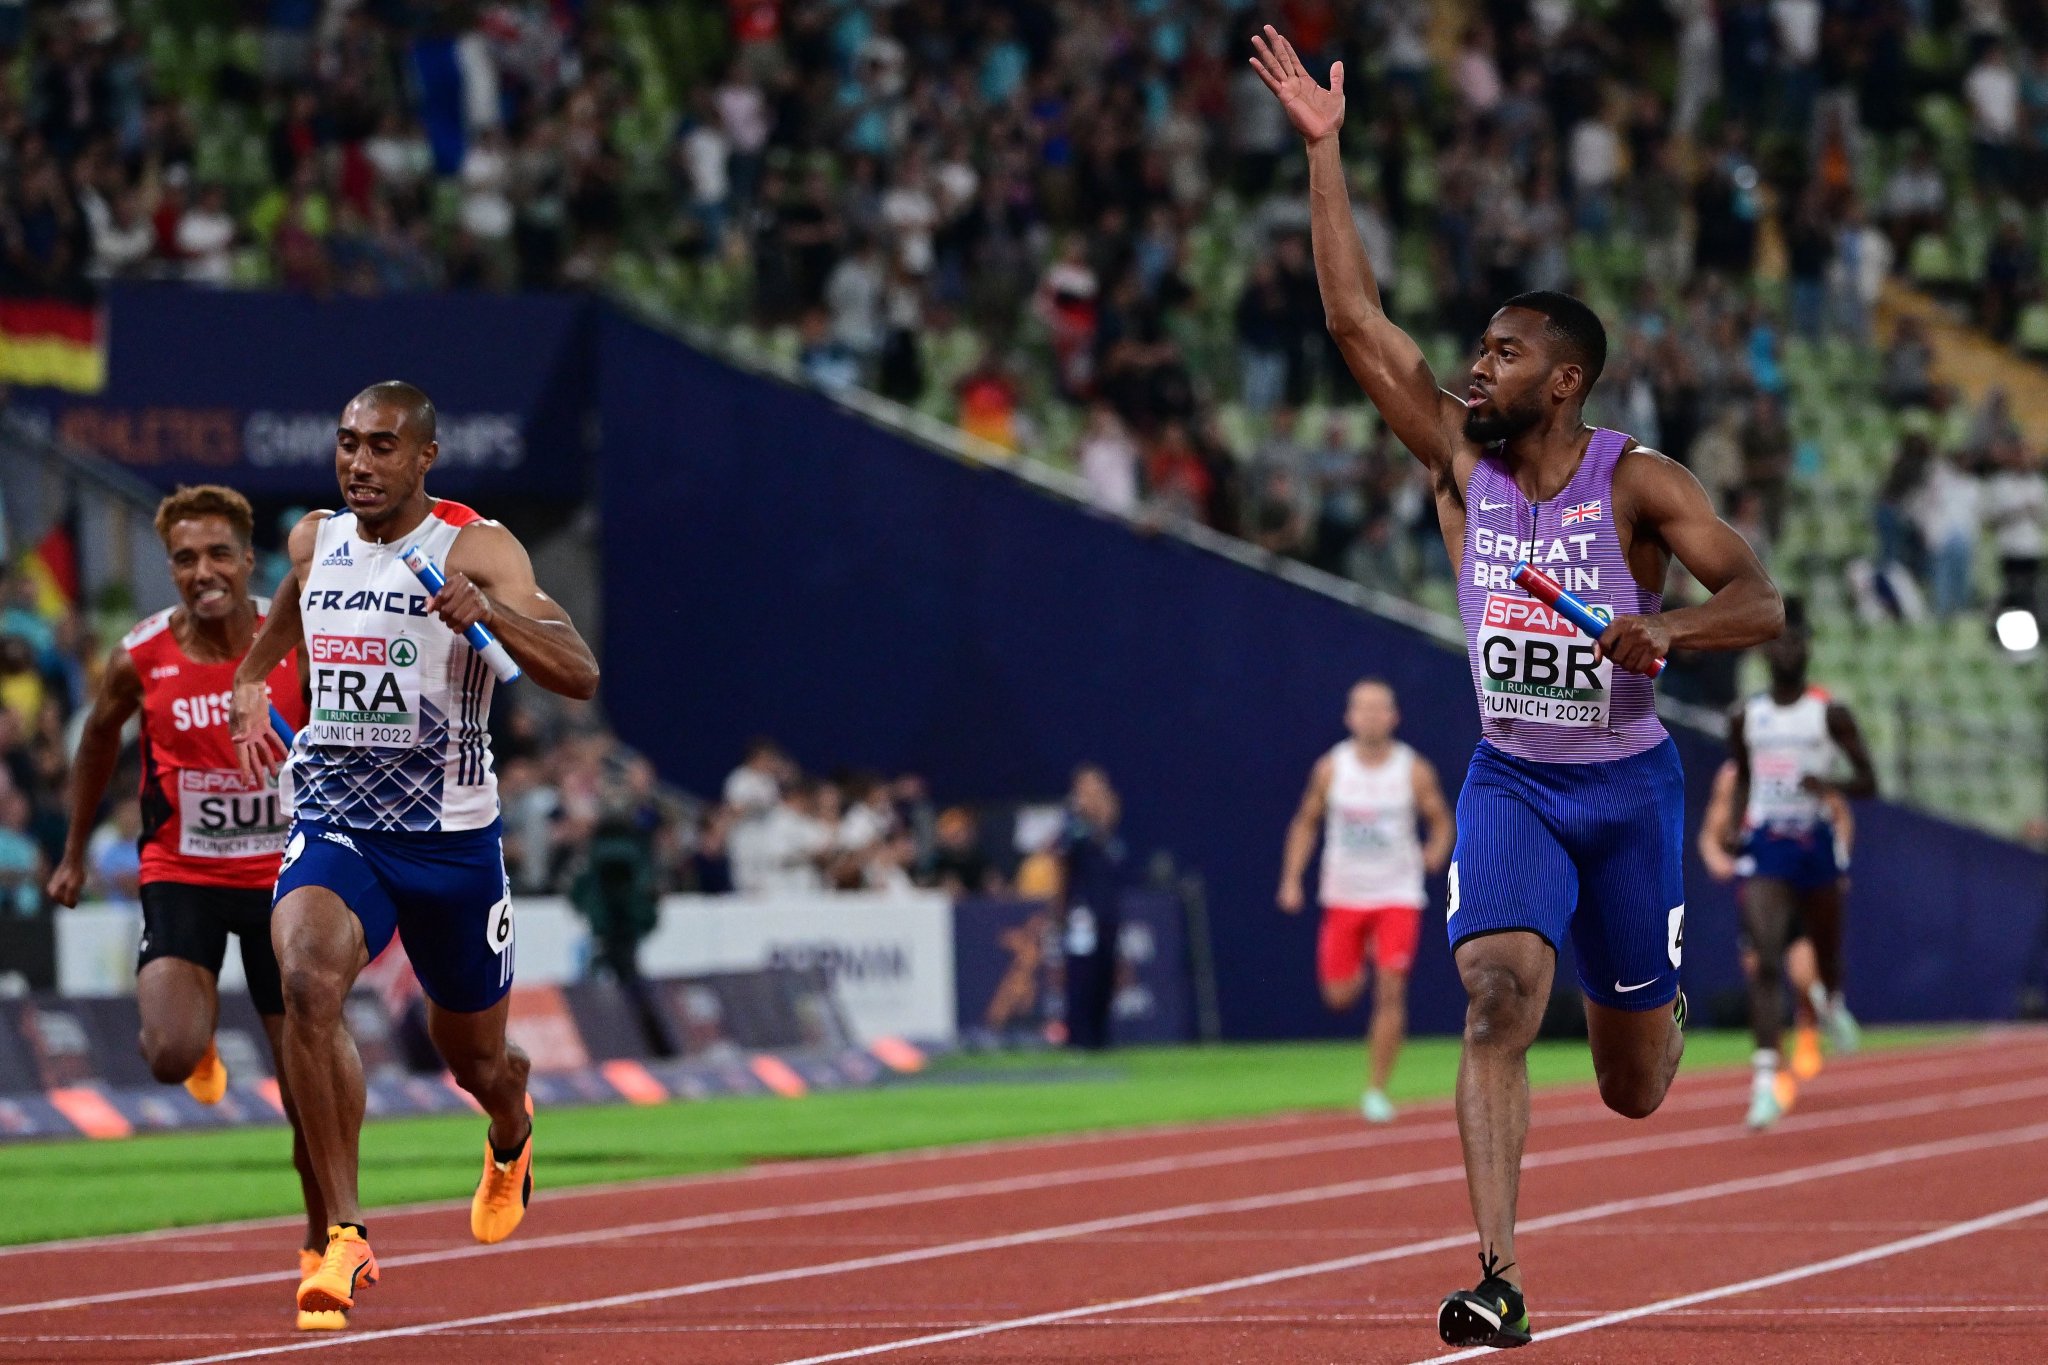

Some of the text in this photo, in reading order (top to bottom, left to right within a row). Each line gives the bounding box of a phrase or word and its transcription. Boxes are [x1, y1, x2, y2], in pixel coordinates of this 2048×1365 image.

[1476, 527, 1596, 563] GREAT
[322, 555, 354, 567] adidas
[1474, 561, 1599, 591] BRIAIN
[307, 590, 428, 617] FRANCE
[313, 638, 385, 663] SPAR
[1483, 635, 1604, 690] GBR
[318, 669, 408, 713] FRA
[1507, 681, 1533, 694] RUN
[331, 711, 350, 720] RUN
[1483, 694, 1601, 722] MUNICH 2022
[314, 724, 411, 743] MUNICH 2022
[200, 795, 275, 829] SUI
[496, 904, 509, 943] 6
